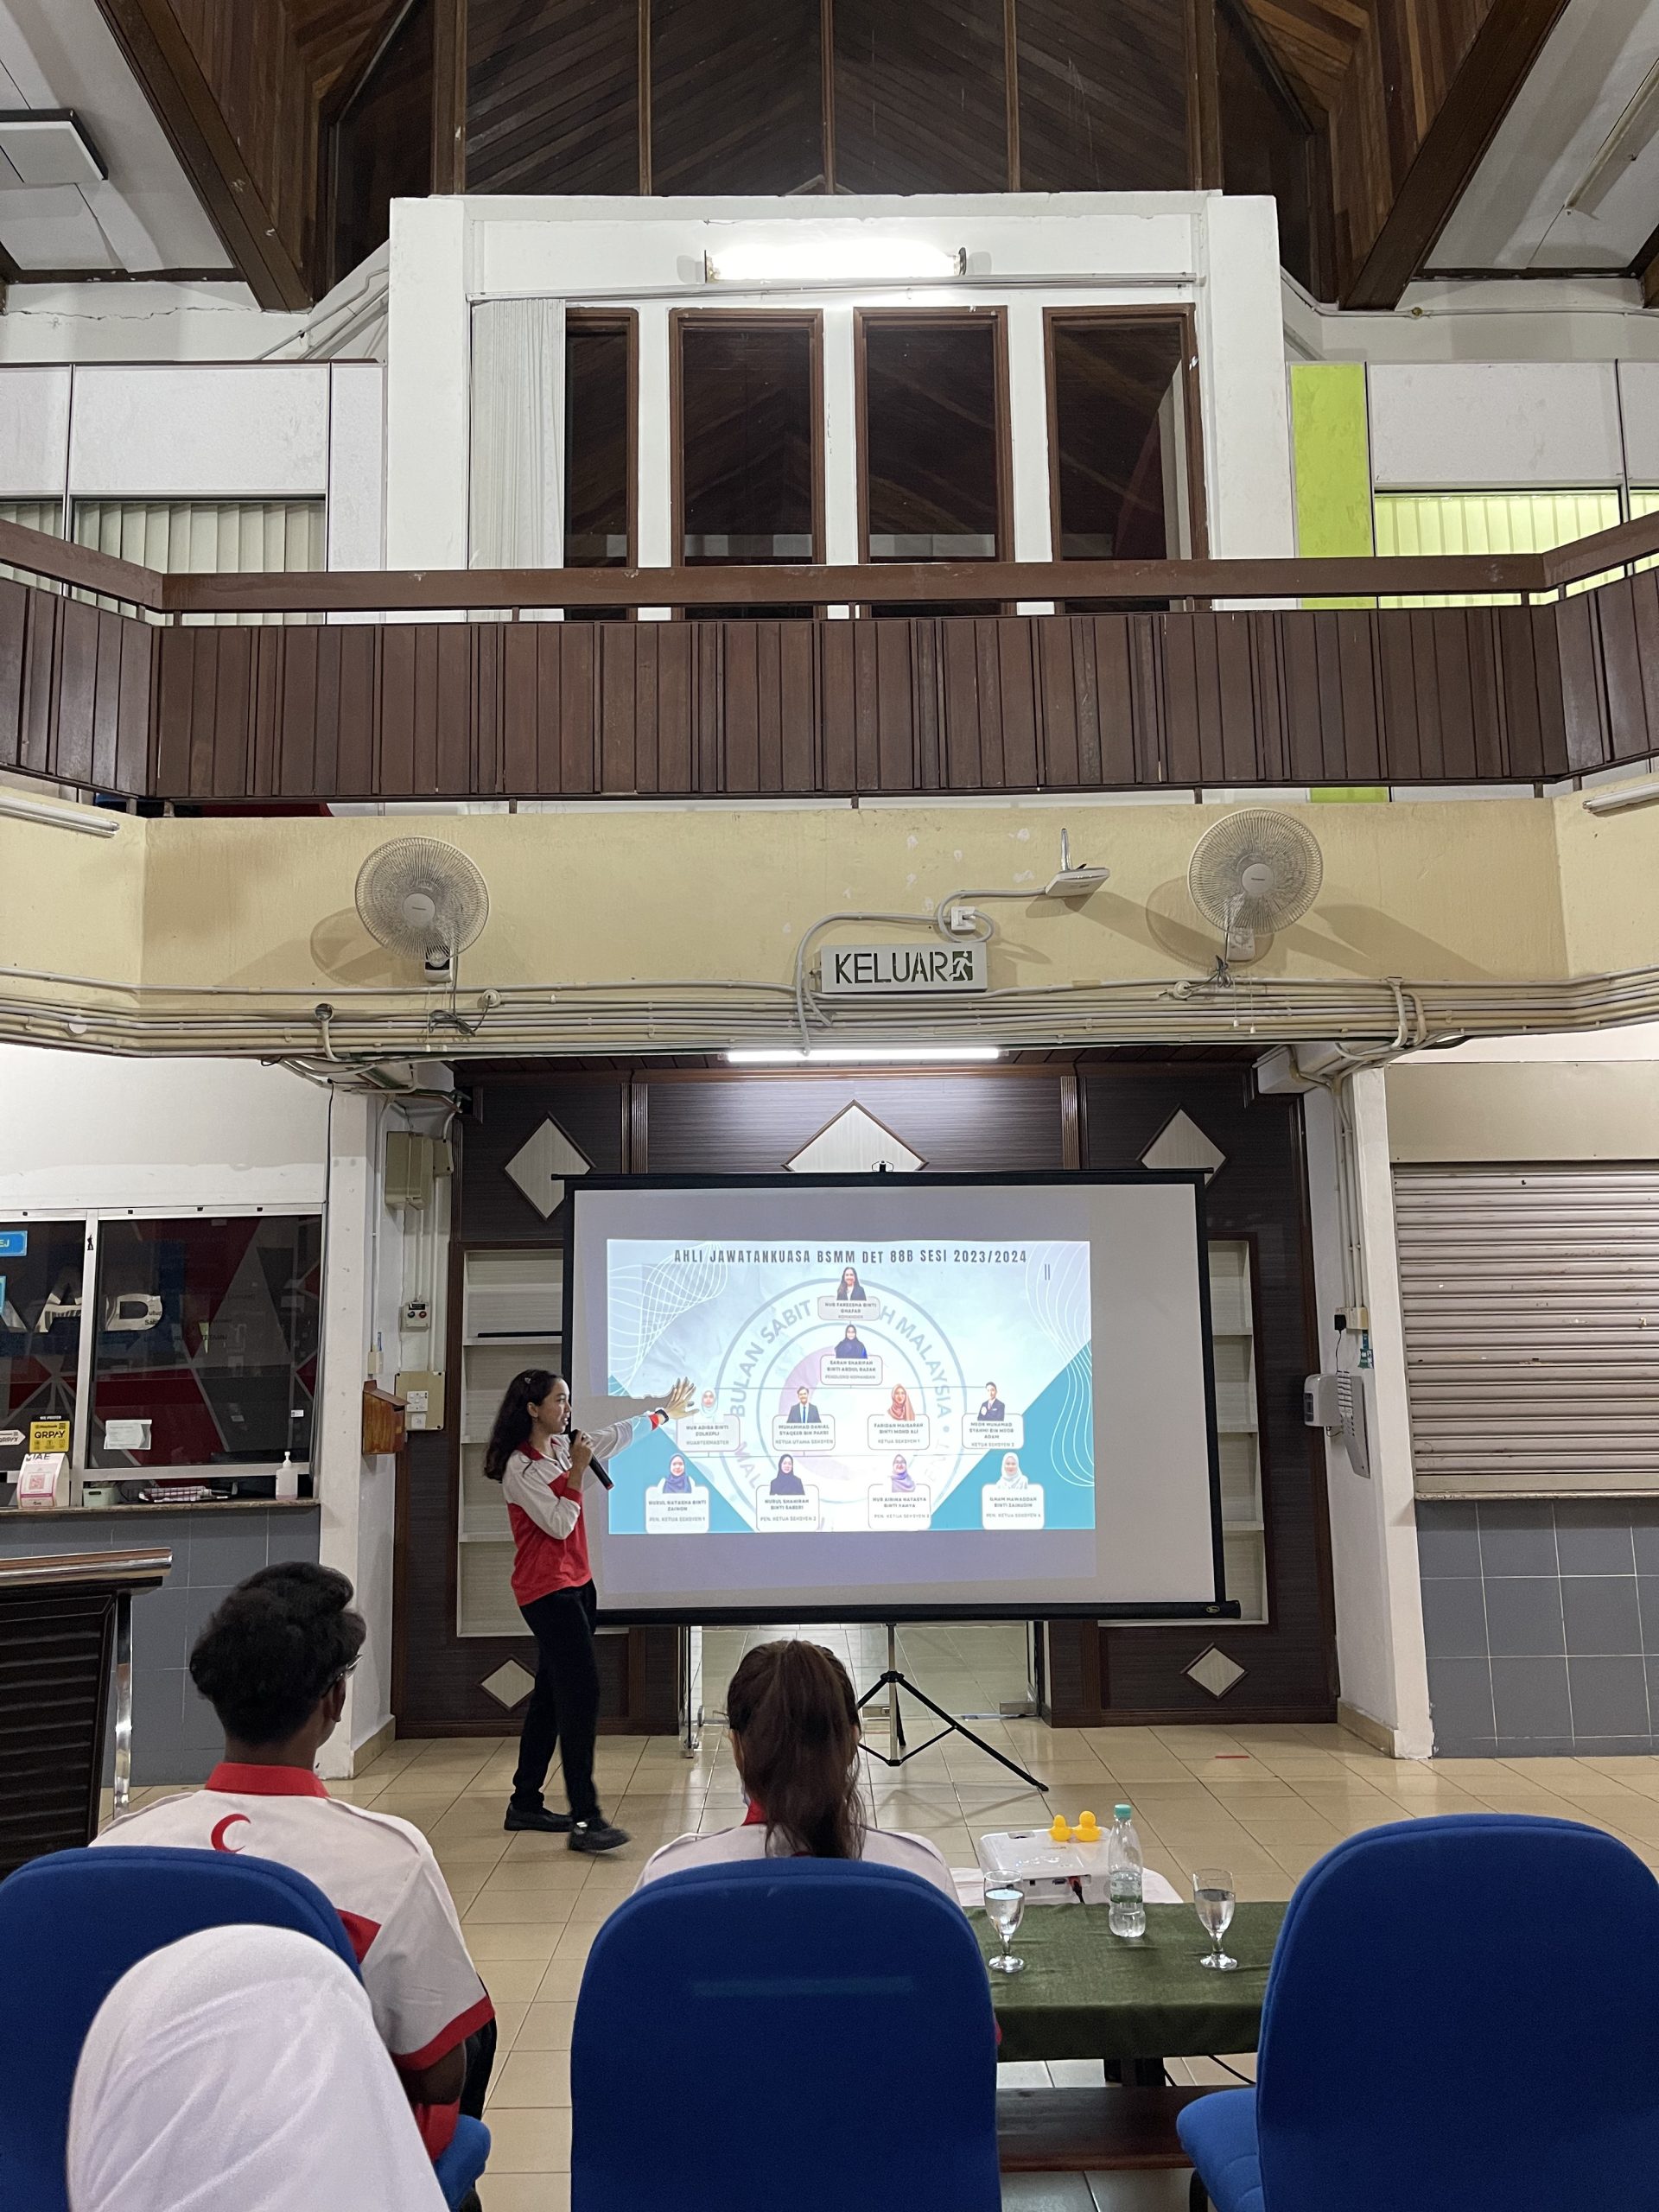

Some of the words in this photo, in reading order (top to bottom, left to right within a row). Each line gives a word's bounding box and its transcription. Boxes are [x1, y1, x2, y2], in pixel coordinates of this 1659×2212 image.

[835, 951, 948, 984] KELUAR
[674, 1249, 702, 1262] AHLI
[709, 1249, 810, 1263] JAWATANKUASA
[817, 1250, 855, 1263] BSMM
[862, 1250, 883, 1263] DET
[890, 1249, 913, 1262] 88B
[920, 1249, 947, 1262] SESI
[954, 1249, 1027, 1263] 2023/2024
[760, 1299, 812, 1344] SABIT
[730, 1341, 765, 1418] BULAN
[894, 1315, 952, 1419] MALAYSIA
[35, 1430, 65, 1439] QRPAY
